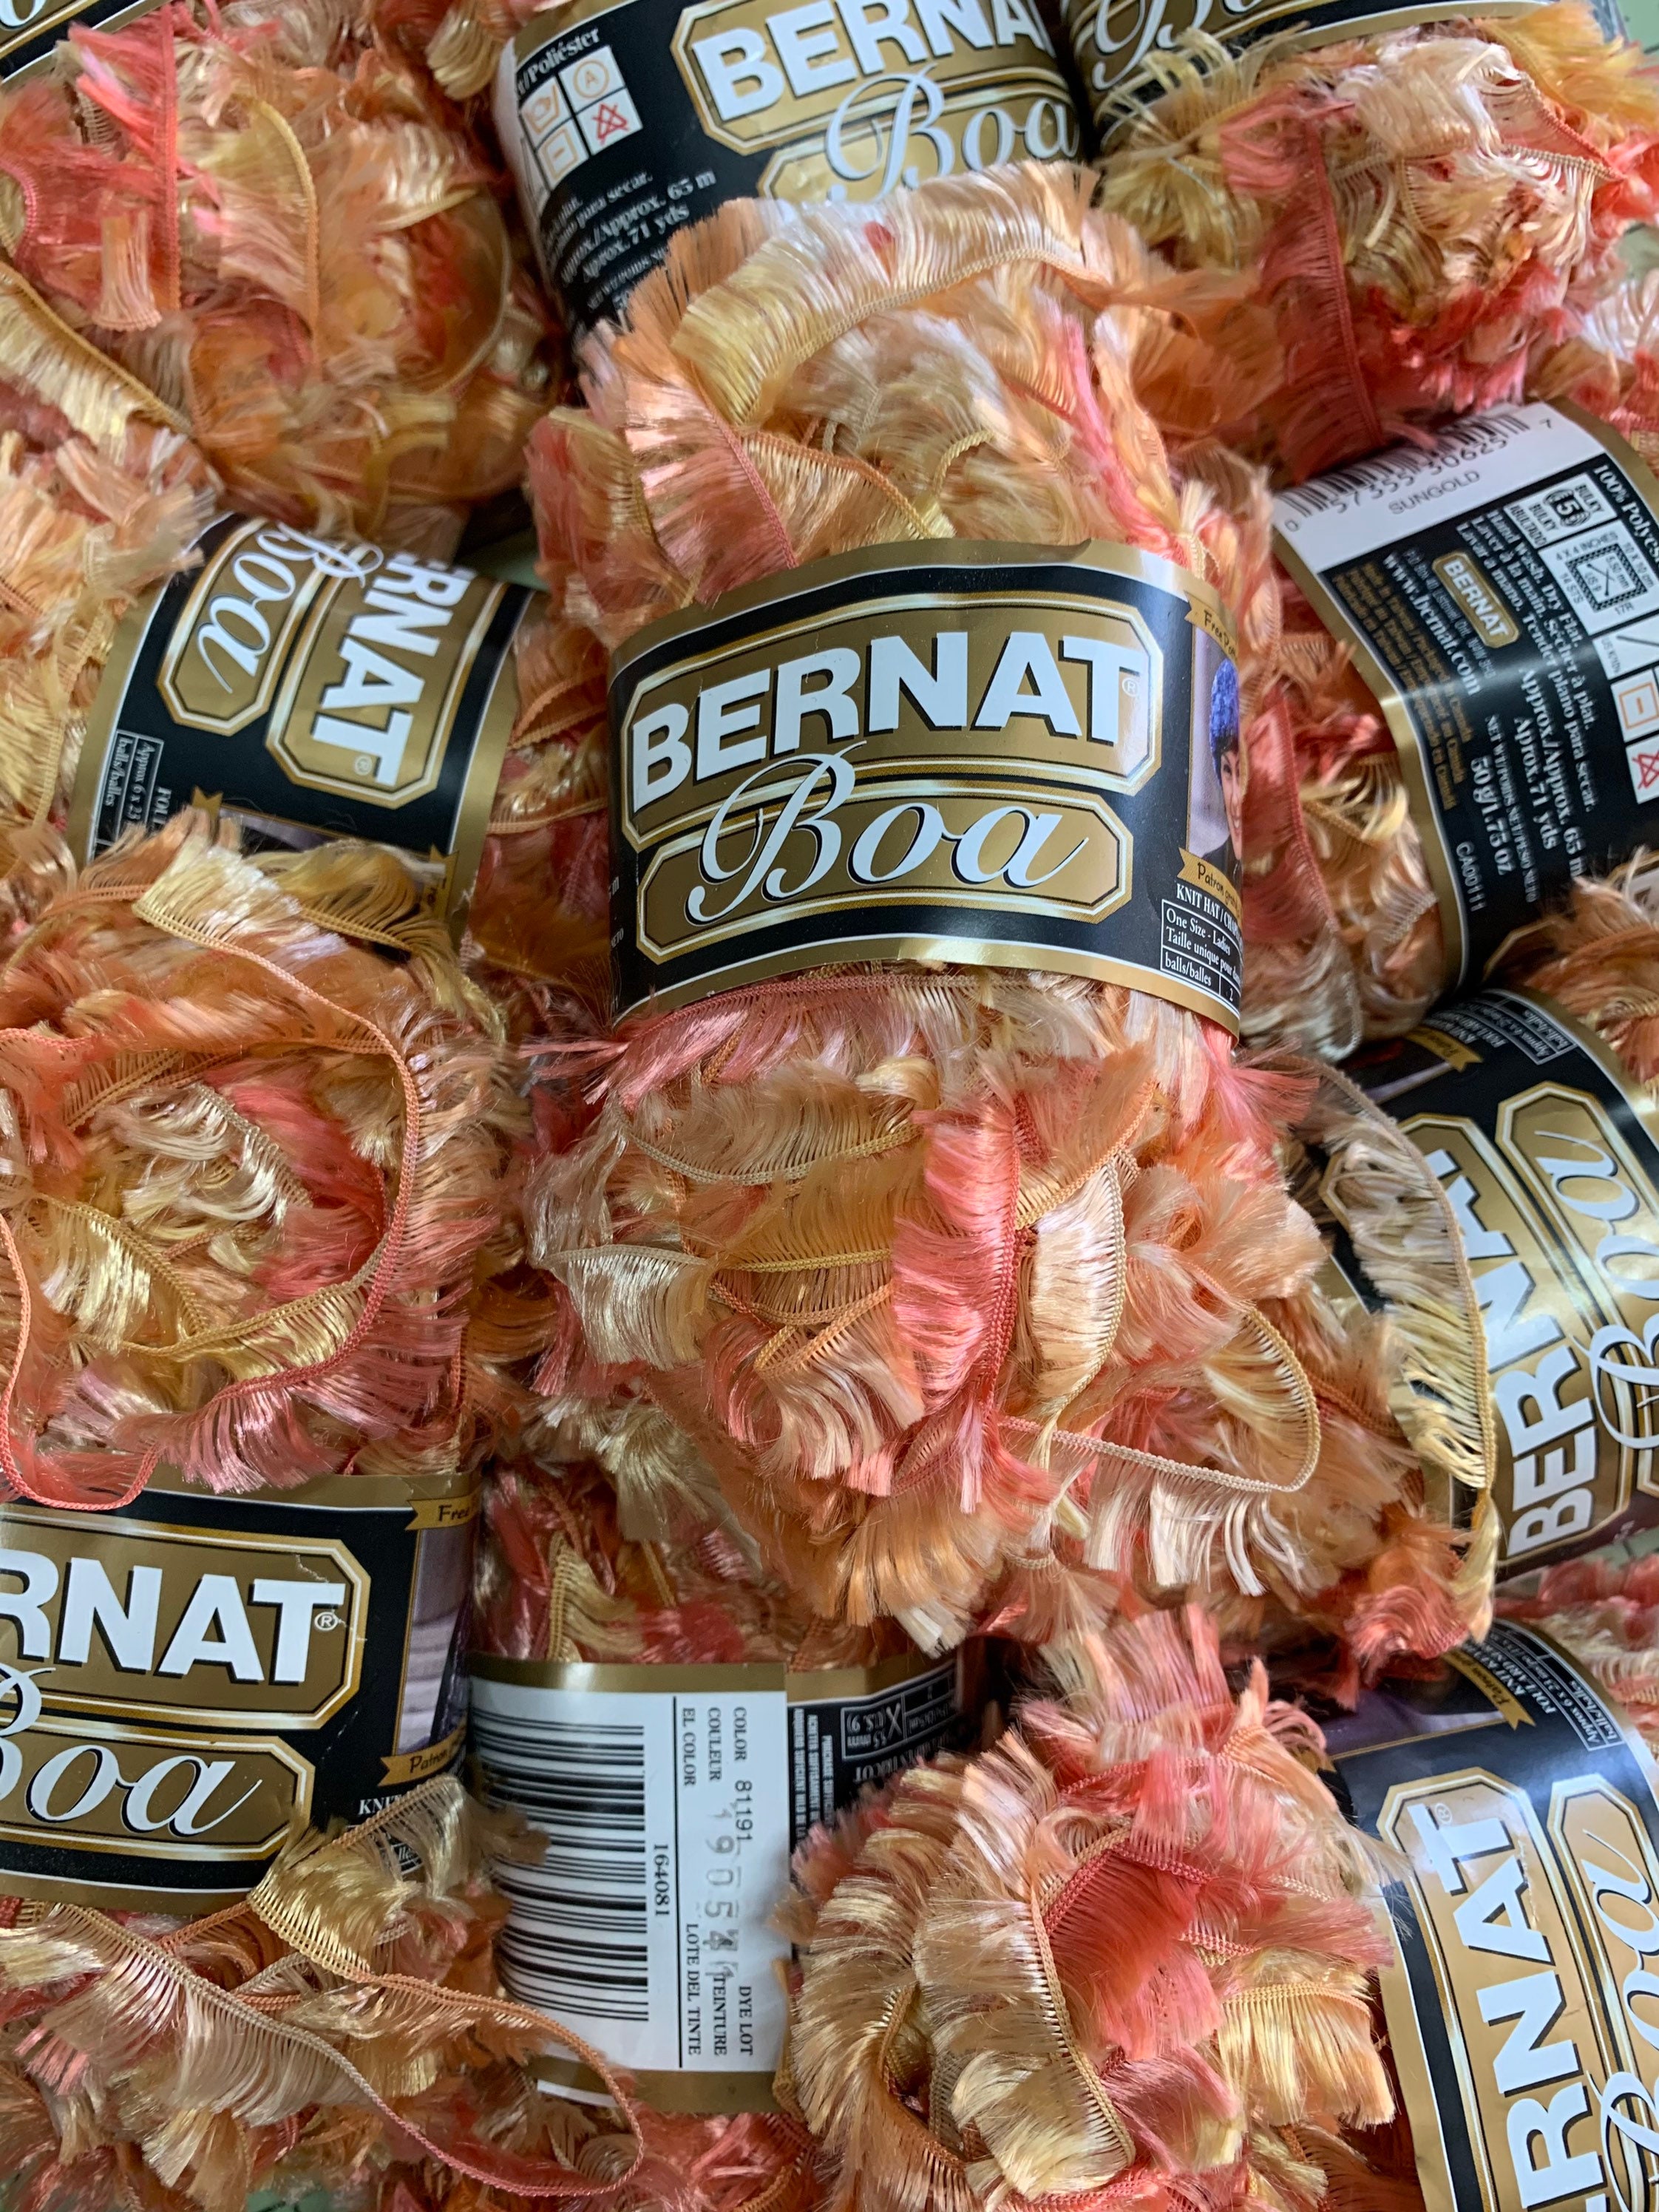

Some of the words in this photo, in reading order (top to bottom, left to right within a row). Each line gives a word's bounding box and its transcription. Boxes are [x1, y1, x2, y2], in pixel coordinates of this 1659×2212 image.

[667, 178, 693, 200] 65
[695, 170, 716, 189] m
[657, 204, 690, 235] yds
[1284, 520, 1300, 532] 0
[1539, 418, 1553, 429] 7
[1388, 469, 1481, 515] SUNGOLD
[1575, 484, 1604, 514] BULKY
[1528, 503, 1559, 532] BULKY
[1593, 464, 1631, 503] 100%
[1621, 501, 1659, 568] Polyes
[1444, 557, 1507, 639] BERNAT
[1487, 509, 1519, 542] Hand
[1514, 543, 1547, 582] Wash.
[1541, 583, 1566, 611] Dry
[1559, 613, 1584, 645] Flat.
[1204, 609, 1223, 643] Free
[1383, 553, 1481, 695] www.bernat.com
[1472, 517, 1503, 552] Laver
[1507, 561, 1524, 577] la
[1518, 576, 1549, 617] main.
[1573, 691, 1595, 728] plat.
[310, 550, 478, 787] RNAT
[1492, 568, 1524, 611] mano.
[1522, 614, 1557, 665] Tender
[1549, 670, 1574, 716] plano
[1564, 722, 1585, 758] para
[1575, 761, 1595, 810] secar.
[631, 631, 1144, 815] BERNAT
[1485, 716, 1500, 741] NET
[1470, 757, 1490, 784] 50
[1513, 716, 1539, 781] Aprox.
[1473, 785, 1506, 847] g/1.75
[1530, 785, 1547, 805] 71
[687, 740, 1090, 925] Boa
[1533, 812, 1559, 849] yds
[1565, 827, 1582, 853] 65
[1197, 862, 1224, 896] Patron
[1456, 841, 1485, 910] CA00111
[1494, 850, 1510, 873] oz
[1569, 858, 1583, 877] m
[1176, 883, 1202, 909] KNIT
[1204, 896, 1221, 920] HAT
[1166, 908, 1187, 929] One
[1190, 917, 1206, 939] Size
[1212, 930, 1231, 956] Ladies
[1166, 926, 1192, 951] Taille
[1194, 943, 1219, 966] unique
[1220, 959, 1232, 977] pour
[1164, 951, 1212, 987] balls/balles
[1424, 1147, 1598, 1558] BERNA
[682, 1707, 695, 1729] EL
[1562, 1698, 1573, 1707] 6
[1570, 1680, 1617, 1740] balls/balles
[1571, 1706, 1599, 1743] Approx
[707, 1707, 722, 1782] COULEUR
[733, 1707, 748, 1761] COLOR
[823, 1736, 832, 1777] PURCHASE
[683, 1731, 696, 1788] COLOR
[735, 1779, 753, 1842] 81191
[654, 1843, 671, 1918] 164081
[686, 1924, 699, 1967] LOTE
[688, 1969, 699, 2001] DEL
[740, 1985, 753, 2017] DYE
[1409, 1801, 1609, 2212] RNAT
[688, 2006, 702, 2056] TINTE
[712, 1972, 728, 2056] TEINTURE
[741, 2019, 754, 2057] LOT
